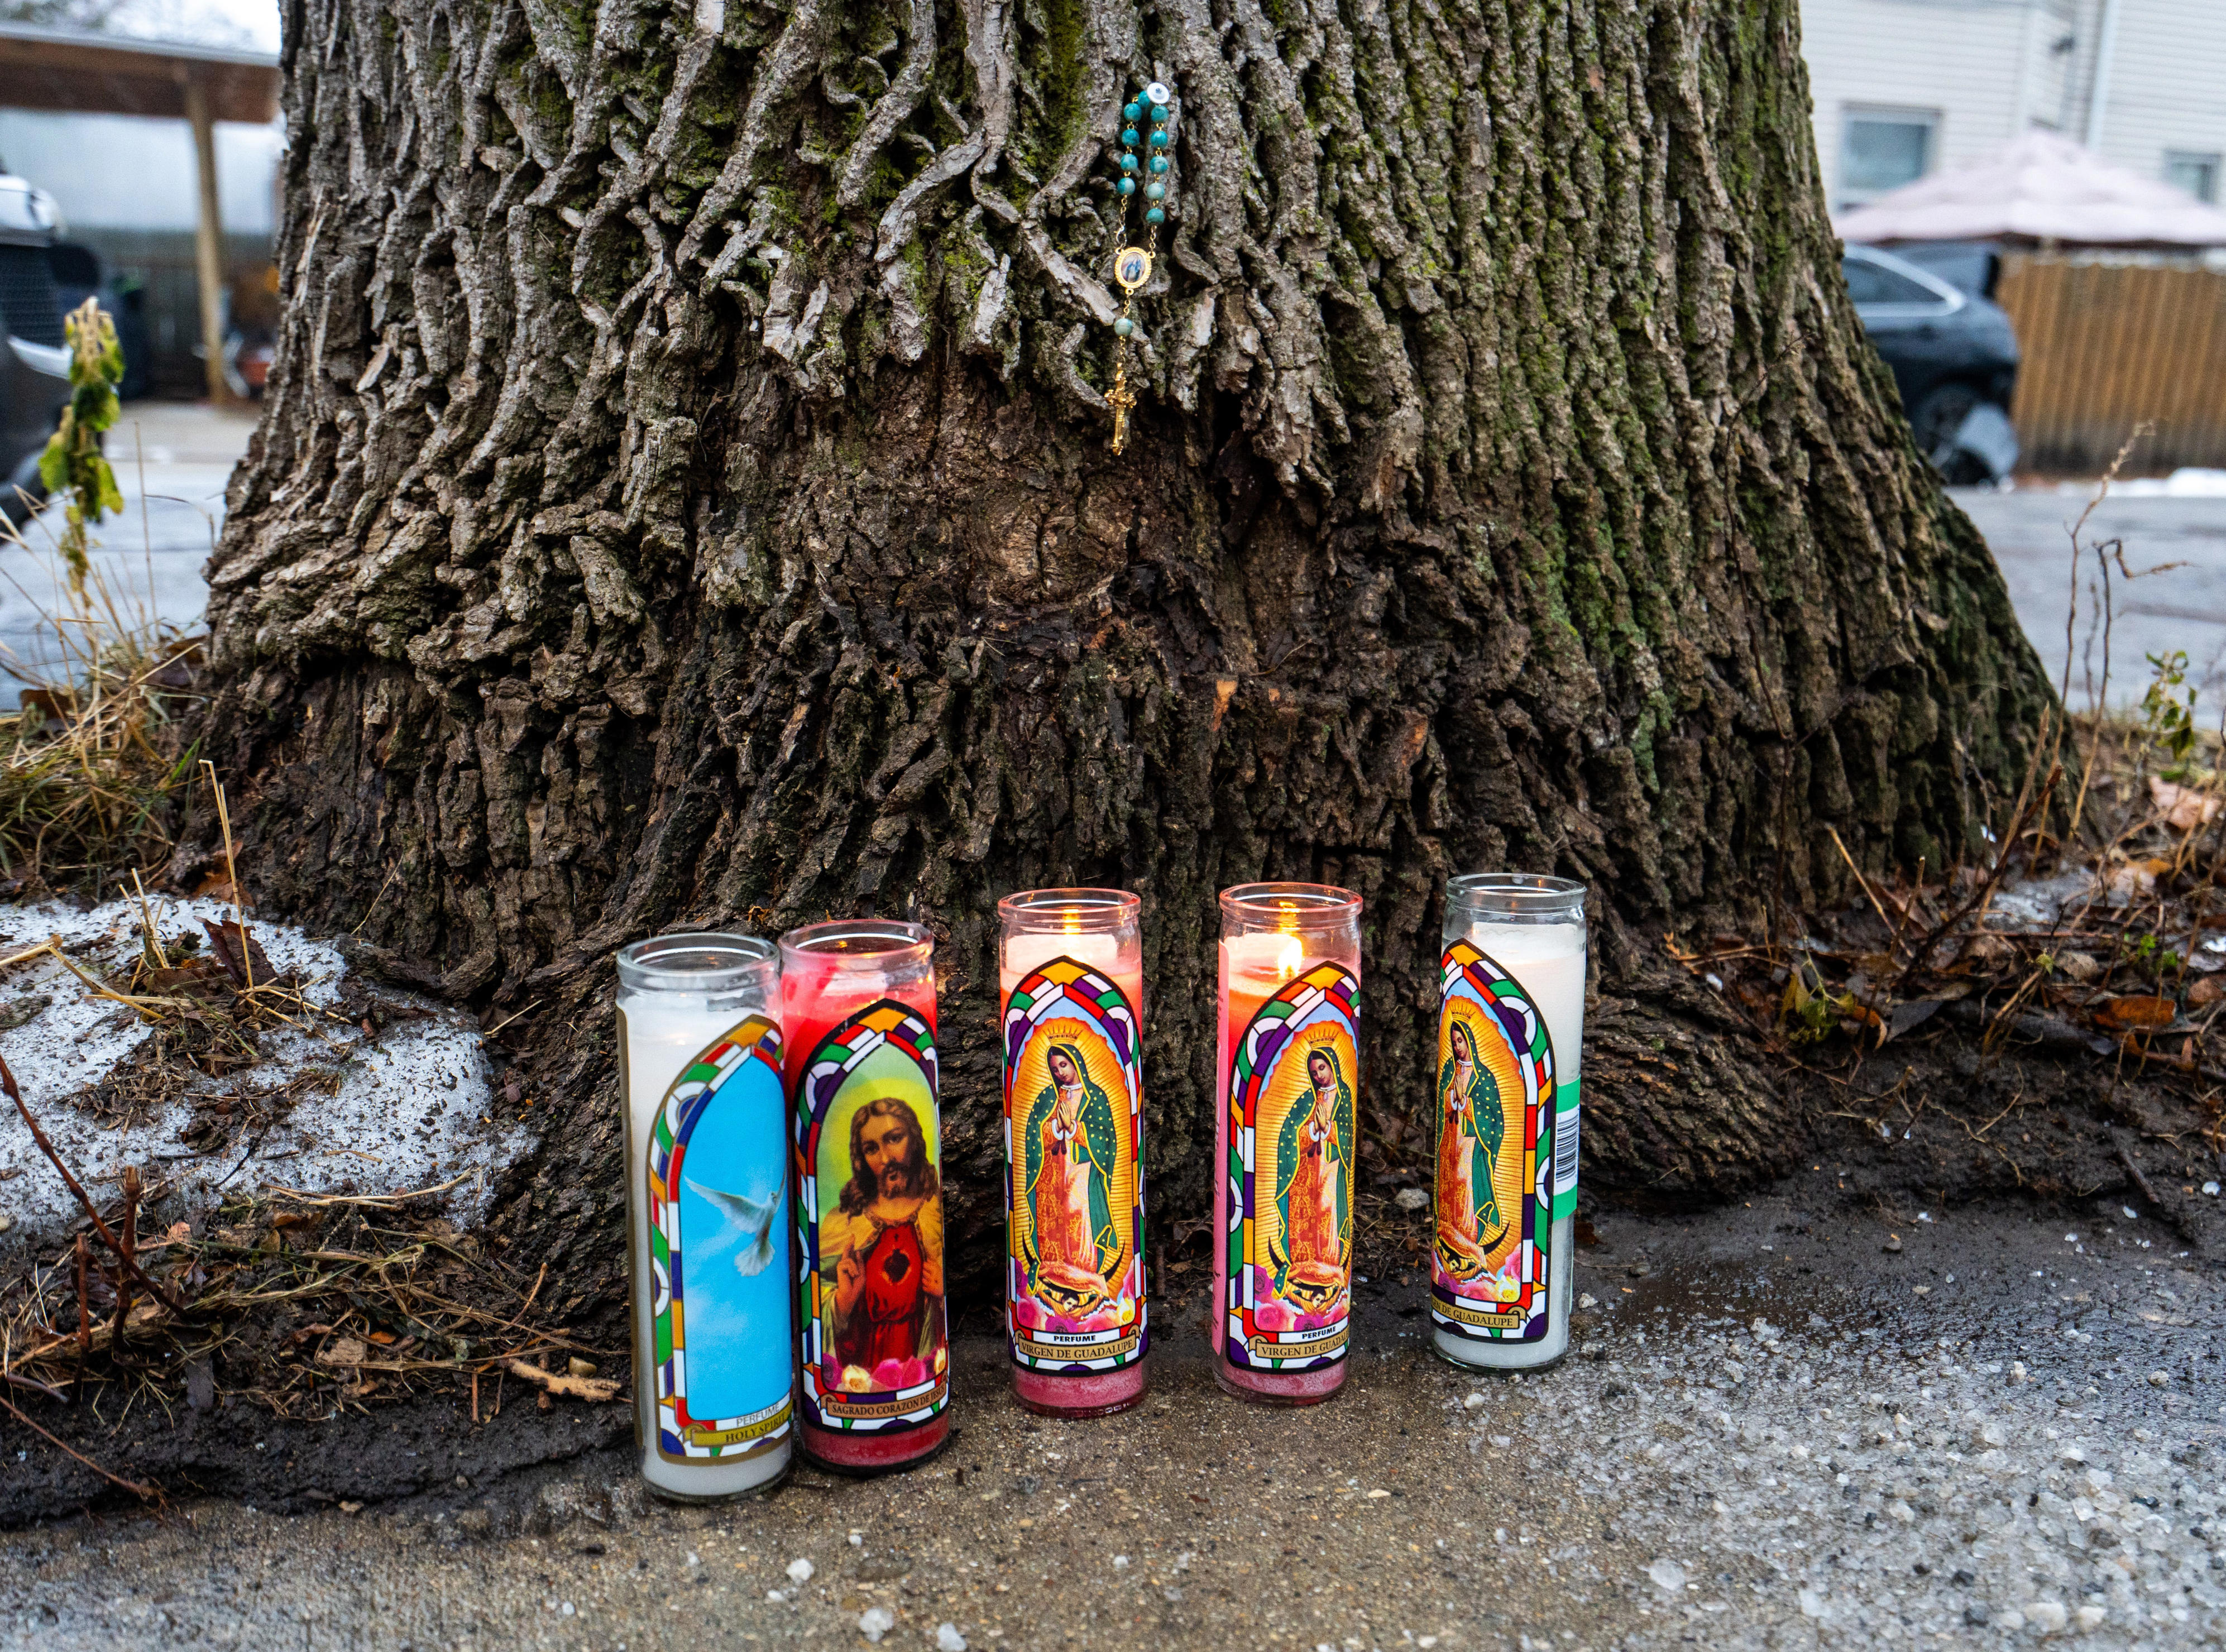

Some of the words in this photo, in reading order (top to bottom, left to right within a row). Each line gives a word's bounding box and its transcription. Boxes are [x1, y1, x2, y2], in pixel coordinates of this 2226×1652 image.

[1442, 1304, 1452, 1316] DE
[1453, 1310, 1513, 1326] GUADALUPE
[1301, 1326, 1336, 1339] PERFUME
[1021, 1342, 1054, 1358] VIRGEN
[1057, 1349, 1071, 1358] DE
[1074, 1339, 1133, 1358] GUADALUPE
[1261, 1346, 1301, 1356] VIRGEN
[1304, 1345, 1317, 1354] DE
[832, 1405, 874, 1415] SAGRADO
[876, 1400, 920, 1415] CORAZON
[920, 1395, 930, 1405] DE
[737, 1403, 779, 1427] PERFUME
[726, 1428, 758, 1442] HOLY
